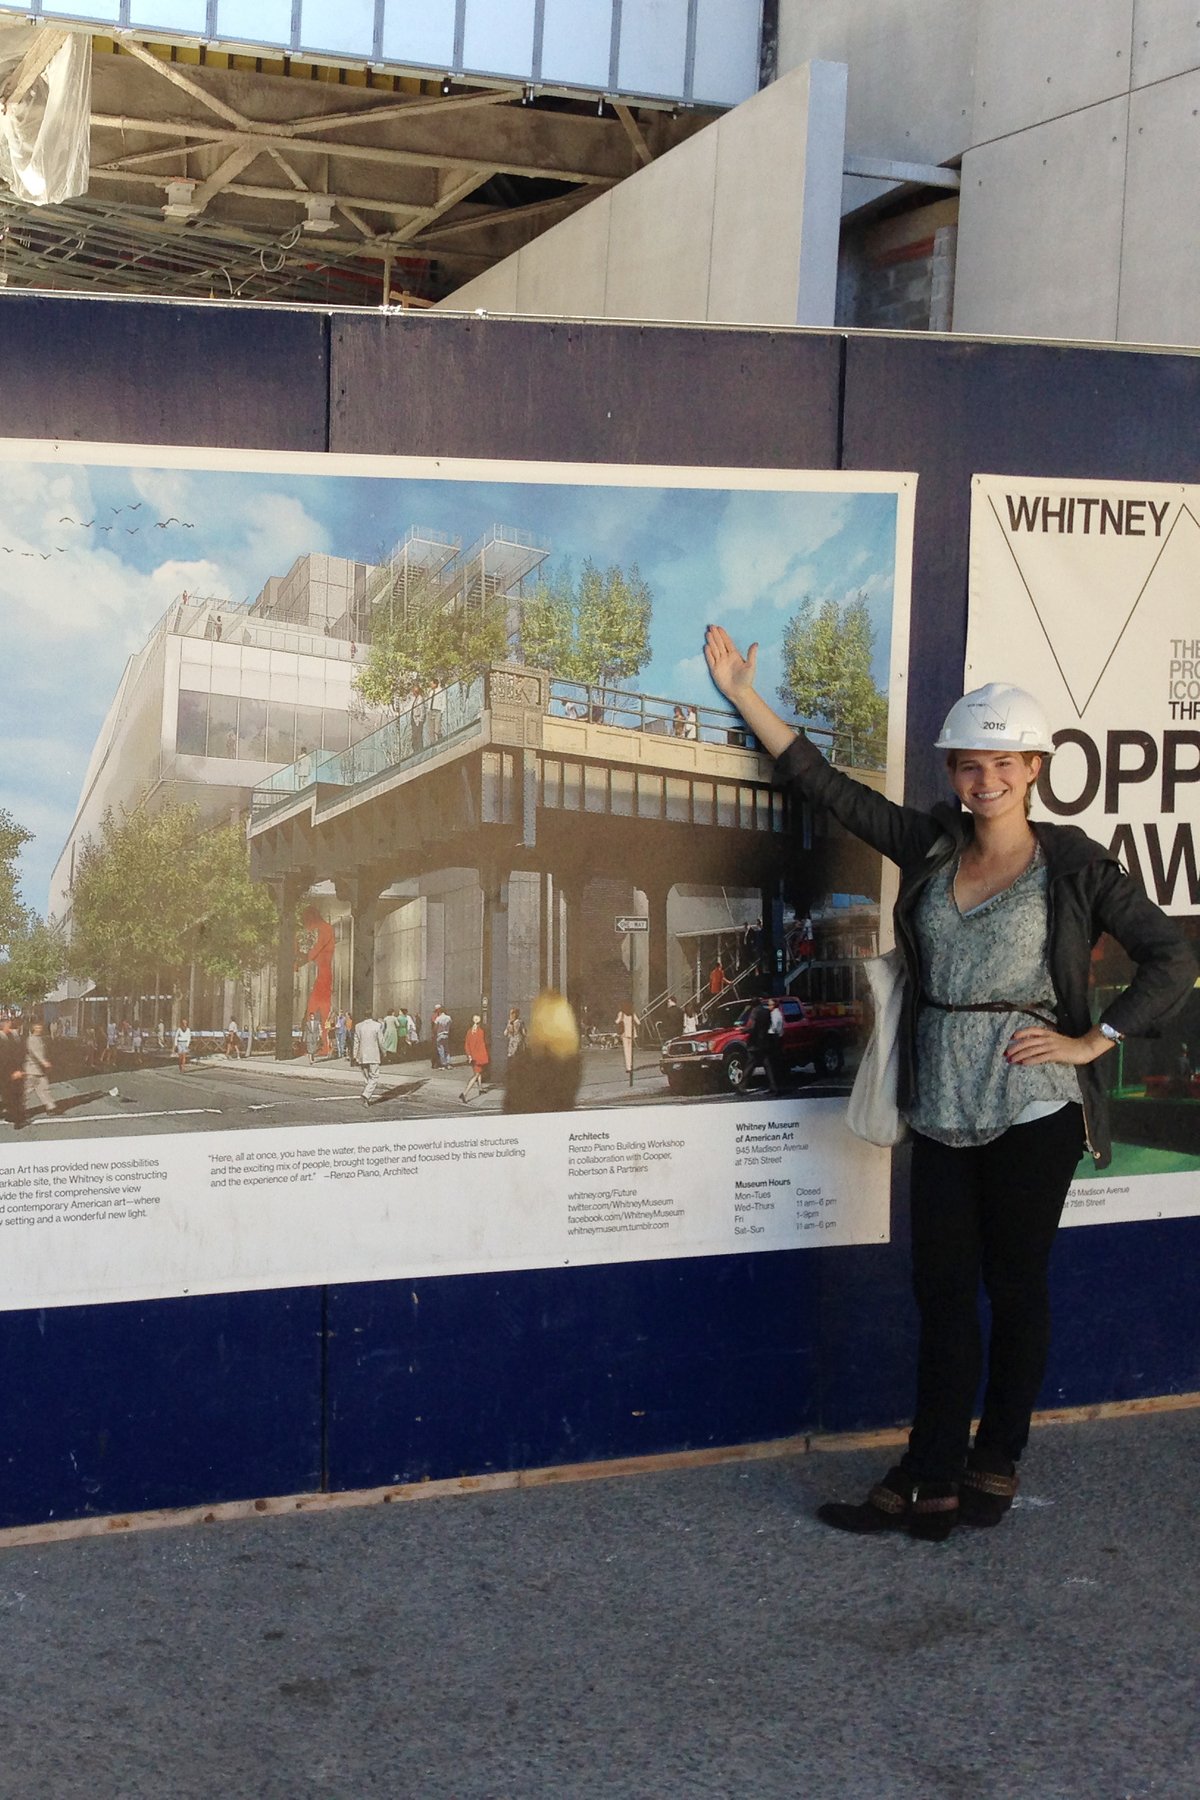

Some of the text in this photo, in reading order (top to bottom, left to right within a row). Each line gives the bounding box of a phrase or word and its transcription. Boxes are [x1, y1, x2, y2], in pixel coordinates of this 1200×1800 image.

[1006, 495, 1170, 537] WHITNEY
[983, 721, 1006, 731] 2015
[1036, 728, 1200, 817] OPP
[1105, 822, 1200, 906] AW
[736, 1121, 799, 1132] Whitney Museum
[569, 1132, 610, 1141] Architects
[735, 1132, 794, 1143] of American Art
[235, 1153, 244, 1161] all
[246, 1153, 254, 1161] at
[256, 1153, 278, 1161] once,
[280, 1152, 295, 1161] you
[297, 1150, 316, 1158] have
[318, 1148, 330, 1157] the
[332, 1148, 355, 1156] water,
[358, 1146, 370, 1155] the
[372, 1145, 392, 1156] park,
[393, 1144, 406, 1153] the
[408, 1142, 442, 1154] powerful
[444, 1140, 478, 1150] industrial
[480, 1139, 518, 1148] structures
[569, 1139, 685, 1153] Renzo Piano Building Workshop
[736, 1143, 809, 1154] 945 Madison Avenue
[210, 1166, 226, 1174] and
[228, 1165, 241, 1174] the
[243, 1163, 274, 1173] exciting
[276, 1162, 291, 1171] mix
[292, 1161, 300, 1170] of
[302, 1160, 331, 1172] people,
[334, 1158, 364, 1169] brought
[366, 1156, 400, 1168] together
[402, 1155, 416, 1164] and
[418, 1153, 450, 1163] focused
[451, 1153, 461, 1163] by
[463, 1152, 476, 1160] this
[496, 1149, 525, 1159] building
[569, 1152, 672, 1165] in collaboration with Cooper,
[735, 1156, 782, 1166] at 75th Street
[17, 1165, 31, 1174] Art
[33, 1164, 49, 1173] has
[51, 1161, 88, 1174] provided
[91, 1162, 109, 1170] new
[111, 1158, 159, 1171] possibilities
[568, 1165, 648, 1176] Robertson & Partners
[33, 1176, 51, 1186] site,
[53, 1175, 67, 1184] the
[69, 1174, 104, 1184] Whitney
[106, 1172, 113, 1181] is
[115, 1170, 167, 1181] constructing
[210, 1178, 226, 1187] and
[228, 1177, 241, 1186] the
[243, 1175, 288, 1187] experience
[290, 1174, 298, 1182] of
[357, 1170, 381, 1178] Piano,
[383, 1167, 418, 1177] Architect
[735, 1178, 791, 1188] Museum Hours
[19, 1190, 33, 1199] the
[35, 1189, 52, 1198] first
[54, 1185, 120, 1198] comprehensive
[122, 1184, 141, 1193] view
[796, 1187, 821, 1196] Closed
[1077, 1186, 1130, 1196] Madison Avenue
[7, 1202, 69, 1213] contemporary
[71, 1198, 112, 1209] American
[1070, 1198, 1106, 1208] 75th Street
[5, 1216, 35, 1226] setting
[37, 1214, 53, 1223] and
[63, 1211, 106, 1222] wonderful
[128, 1209, 147, 1220] light.
